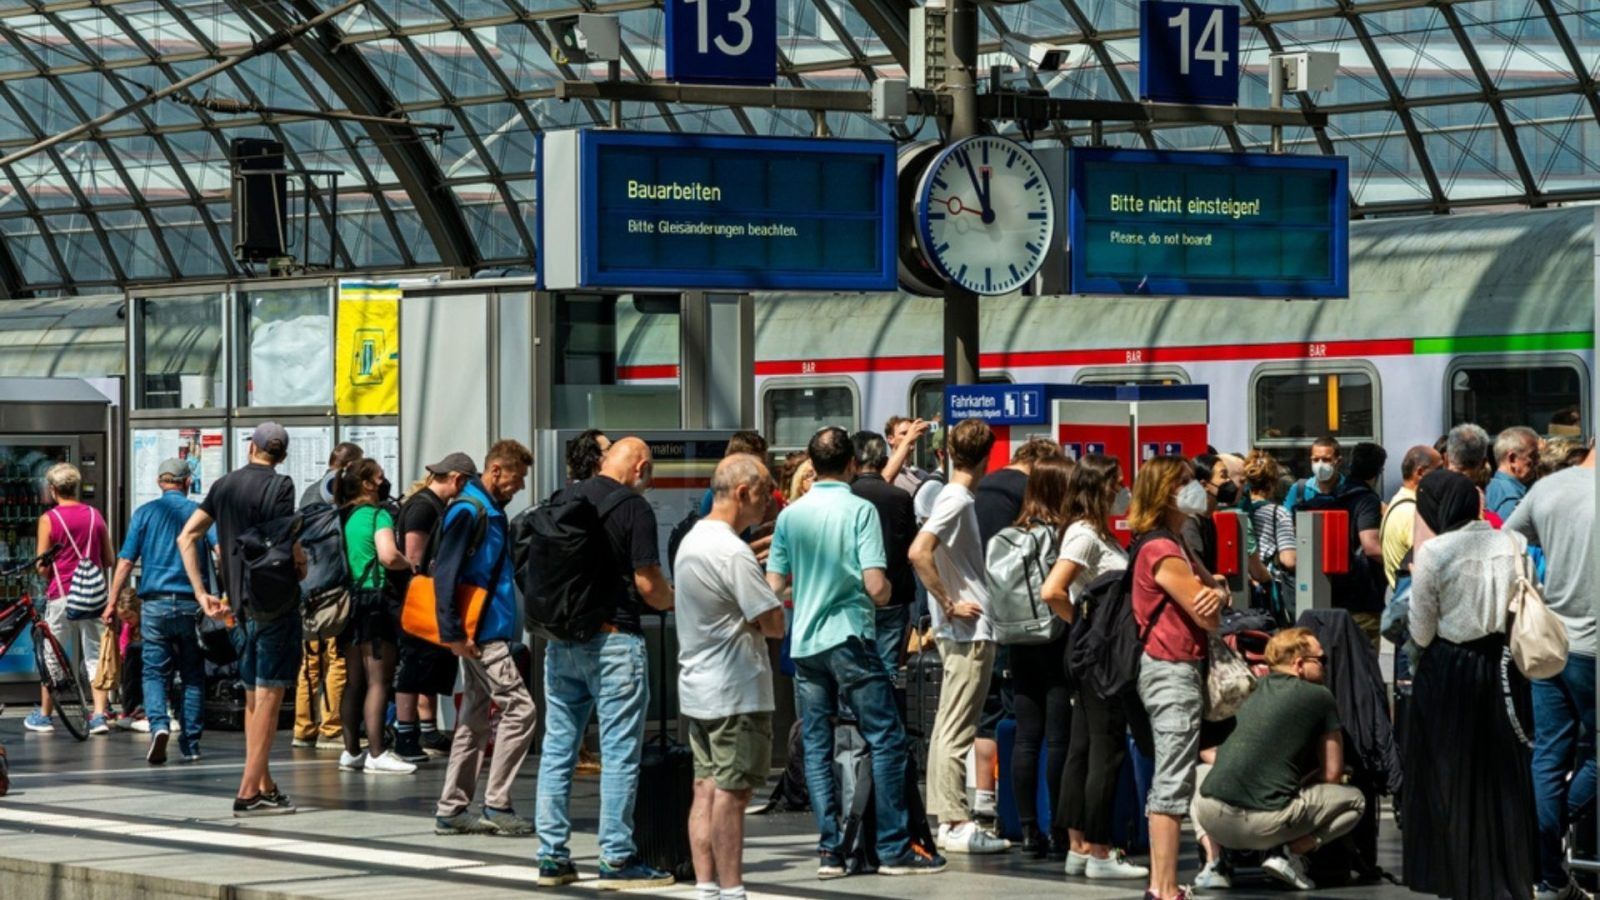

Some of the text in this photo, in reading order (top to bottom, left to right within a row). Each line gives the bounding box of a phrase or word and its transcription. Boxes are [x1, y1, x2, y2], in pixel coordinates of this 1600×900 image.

[684, 0, 753, 56] 13
[1168, 7, 1229, 76] 14
[628, 180, 721, 200] Bauarbeiten
[1110, 194, 1260, 219] Bitte nicht einsteigen!
[628, 219, 798, 238] Bitte Gleisänderungen beachten.
[1110, 231, 1212, 246] Please, do not board!
[1126, 351, 1141, 363] BAR
[1309, 344, 1327, 357] BAR
[951, 394, 996, 408] Fahrkarten
